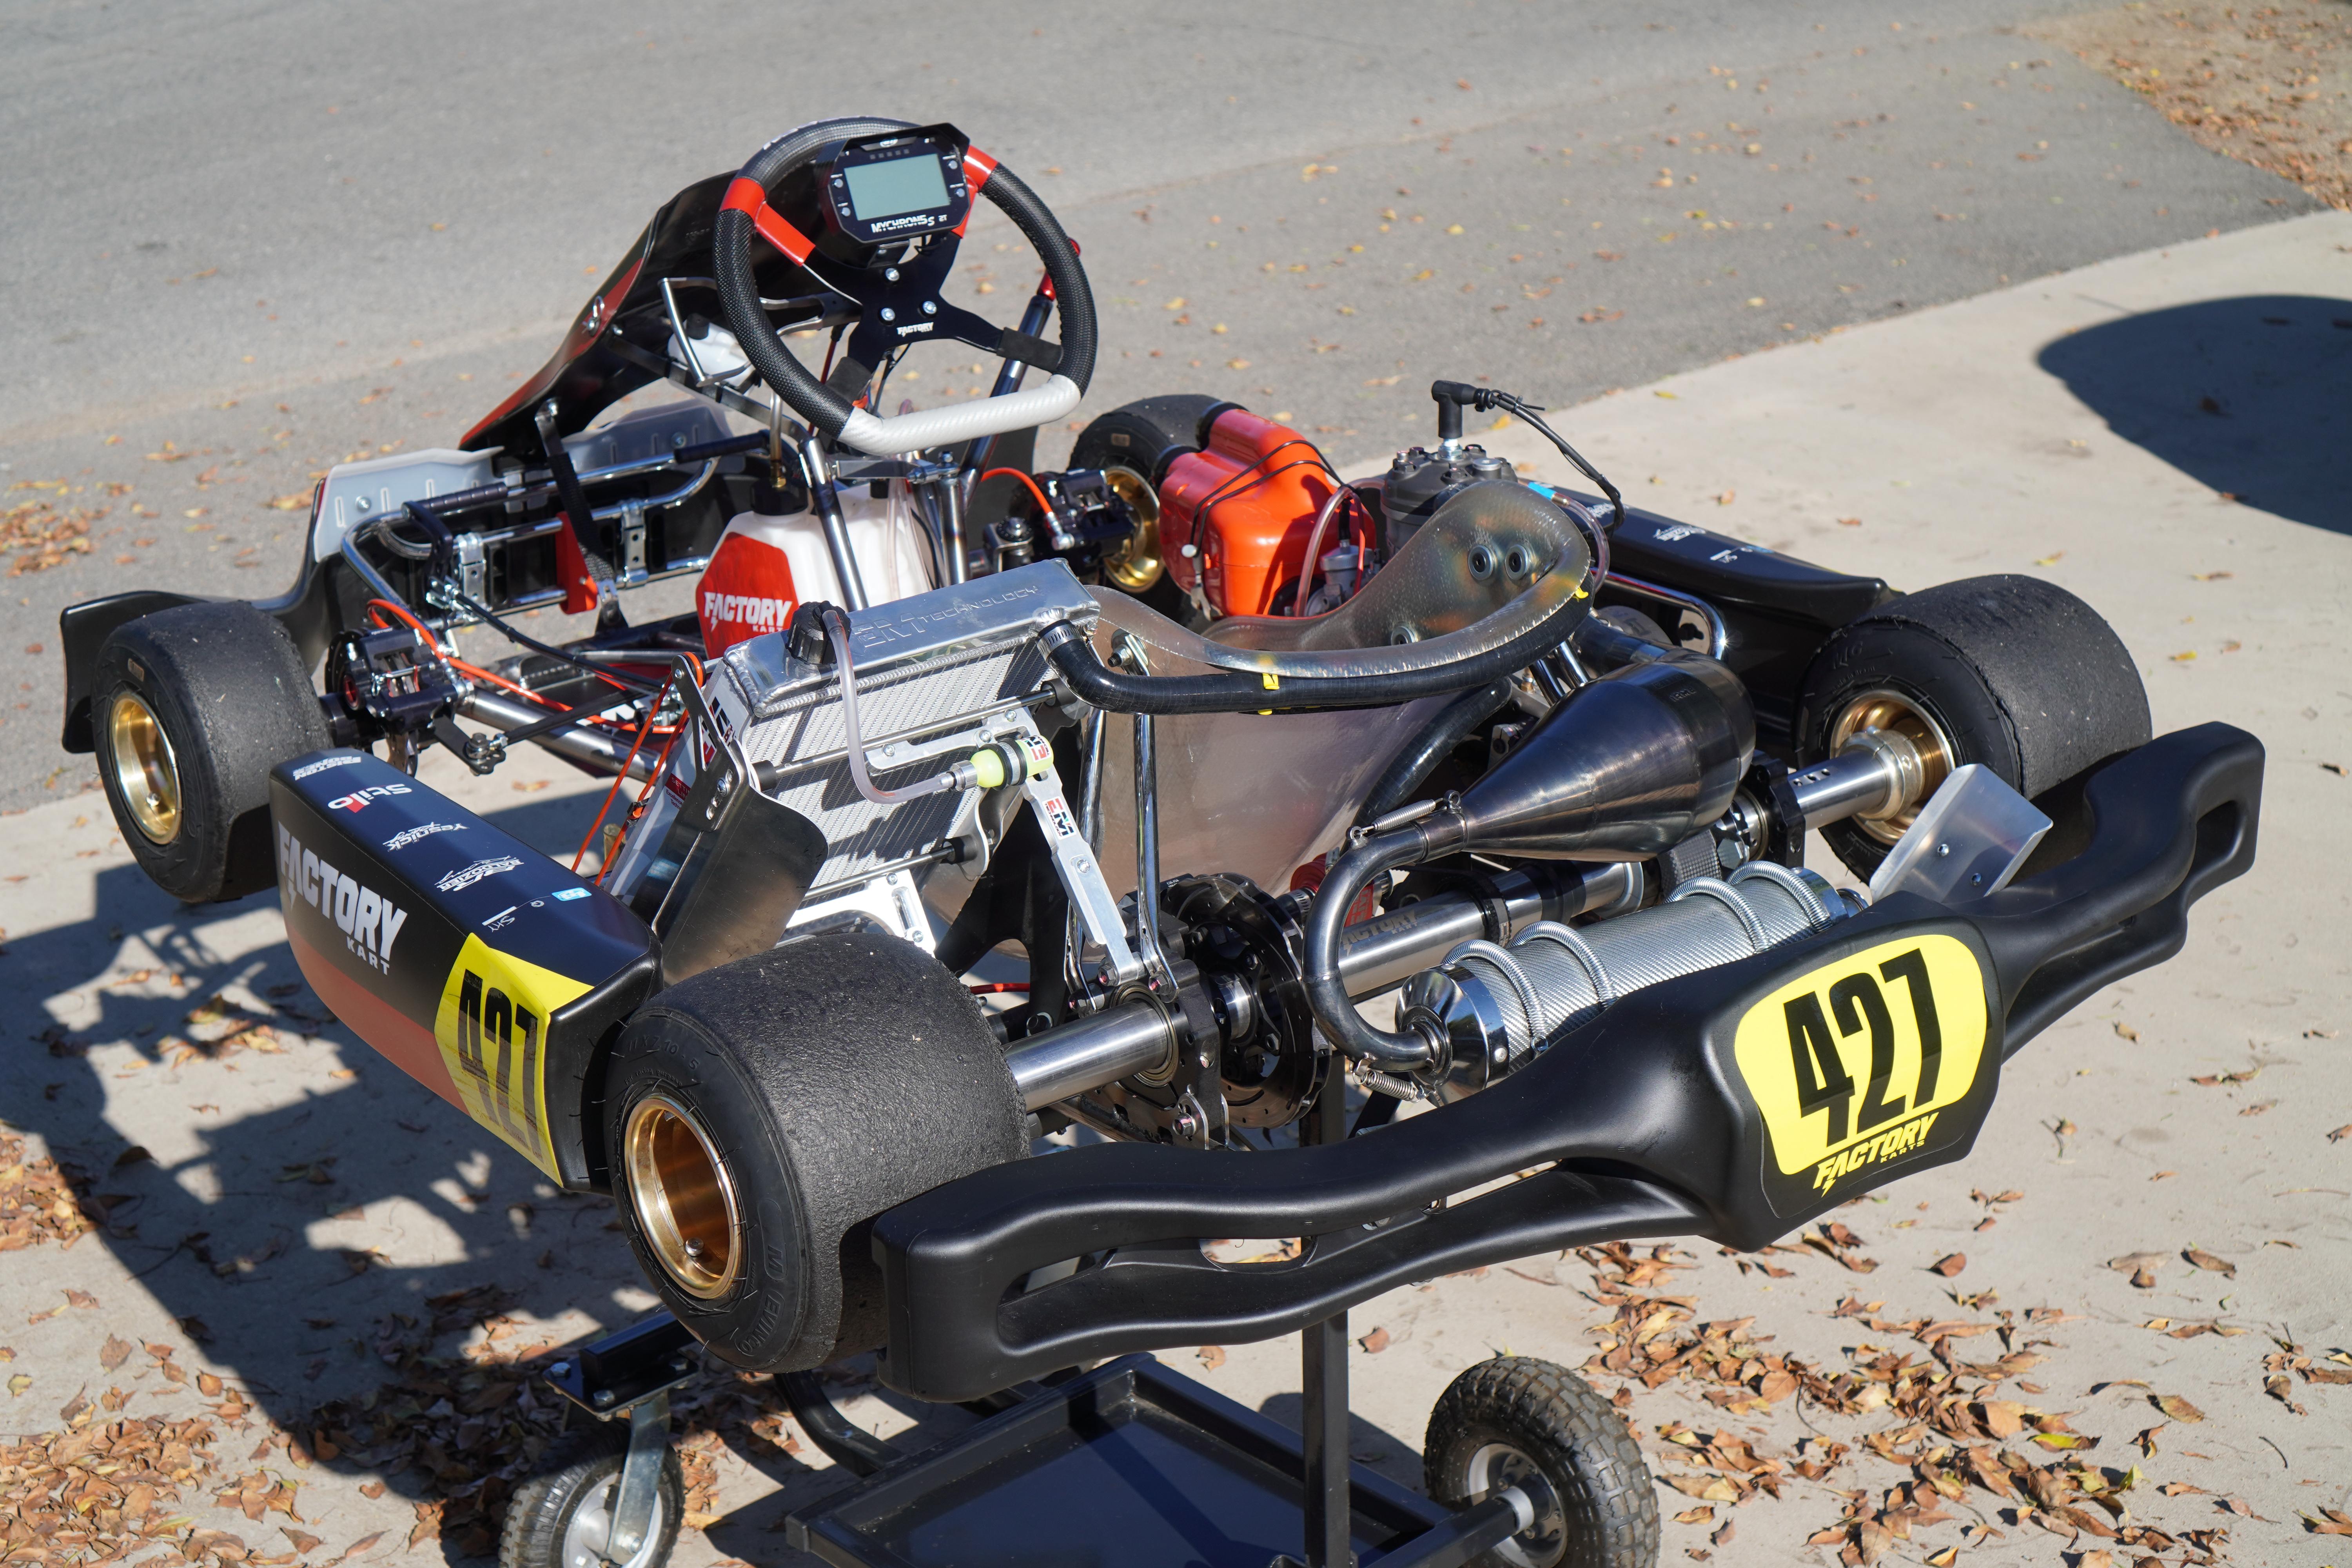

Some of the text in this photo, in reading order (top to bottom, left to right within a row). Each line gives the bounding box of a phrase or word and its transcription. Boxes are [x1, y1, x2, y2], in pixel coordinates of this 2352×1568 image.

[897, 322, 933, 337] FACTORY
[704, 592, 792, 632] FACTORY
[916, 586, 1038, 623] TECHNOLOGY
[295, 757, 361, 780] PISTON
[328, 784, 412, 809] Stilo
[1047, 798, 1074, 836] EM
[386, 823, 470, 852] Yesnick
[278, 821, 408, 962] FACTORY
[437, 859, 524, 892] BALDOZIER
[488, 916, 515, 933] SKY
[1341, 910, 1417, 957] ACTORY
[347, 936, 390, 975] KART
[457, 969, 544, 1163] 427
[688, 1058, 700, 1070] 5
[1783, 947, 1942, 1148] 427
[635, 1067, 654, 1077] racing
[1813, 1112, 1939, 1198] FACTORY
[1880, 1140, 1925, 1163] KARTS
[740, 1294, 781, 1352] EVINCO
